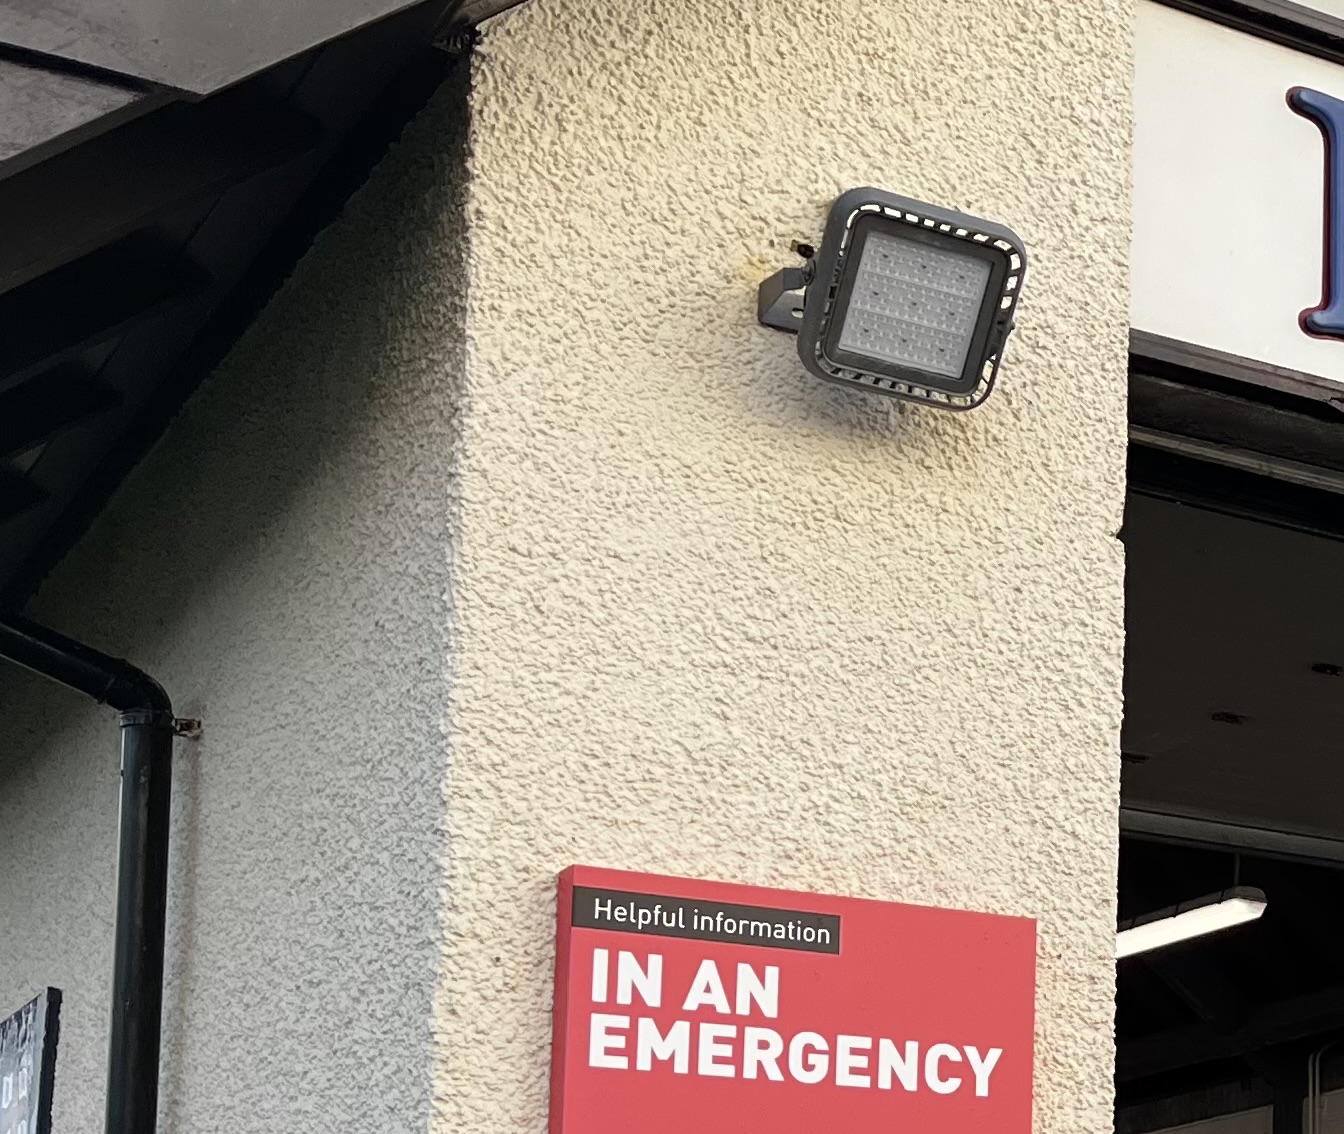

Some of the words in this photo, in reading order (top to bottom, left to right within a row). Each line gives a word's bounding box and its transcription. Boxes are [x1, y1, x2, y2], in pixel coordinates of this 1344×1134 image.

[594, 897, 686, 930] Helpful
[693, 908, 830, 944] information
[591, 948, 663, 1008] IN
[682, 959, 780, 1019] AN
[588, 1014, 1003, 1097] EMERGENCY
